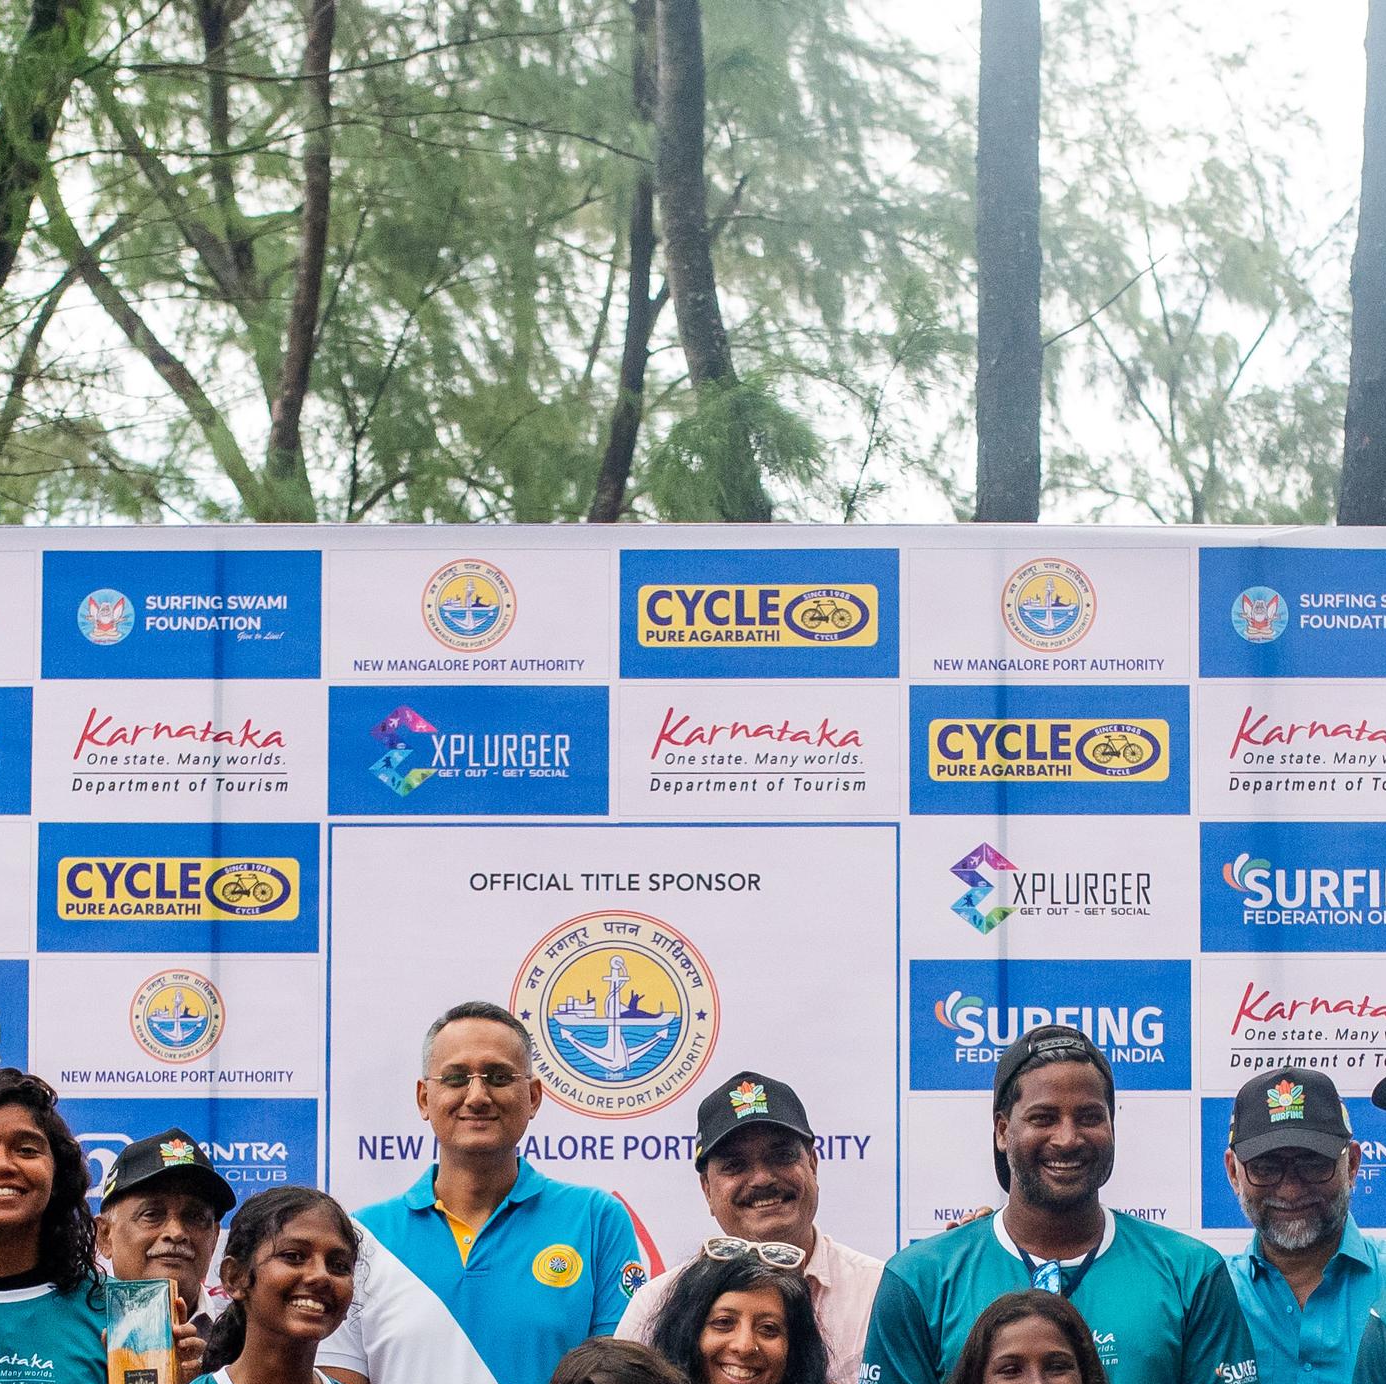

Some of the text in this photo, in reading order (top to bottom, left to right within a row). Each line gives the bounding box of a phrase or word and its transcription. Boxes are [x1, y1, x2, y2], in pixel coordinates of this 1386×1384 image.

[146, 596, 287, 610] SURFING SWAMI
[802, 590, 851, 600] SINCE 1948
[1300, 594, 1376, 608] SURFING
[647, 590, 779, 626] CYCLE
[146, 616, 261, 630] FOUNDATION
[646, 630, 780, 642] PURE AGARBATHI
[354, 659, 584, 671] NEW MANGALORE PORT AUTHORITY
[934, 658, 1164, 671] NEW MANGALORE PORT AUTHORITY
[77, 707, 287, 758] Karnataka
[652, 707, 863, 758] Karnataka
[937, 724, 1071, 760] CYCLE
[87, 752, 286, 768] One state. Many worlds.
[937, 764, 1071, 777] PURE AGARBATHI
[72, 777, 288, 795] Department of Tourism
[650, 777, 866, 795] Department of Tourism
[67, 863, 201, 900] CYCLE
[470, 873, 760, 891] OFFICIAL TITLE SPONSOR
[66, 903, 201, 915] PURE AGARBATHI
[1244, 907, 1362, 924] FEDERATION
[1127, 1048, 1165, 1062] INDIA
[61, 1070, 293, 1083] NEW MANGALORE PORT AUTHORITY
[537, 1061, 613, 1109] MANGALORE
[618, 1090, 652, 1109] PORT
[655, 1032, 706, 1098] AUTHORITY
[358, 1136, 694, 1161] NEW PORT
